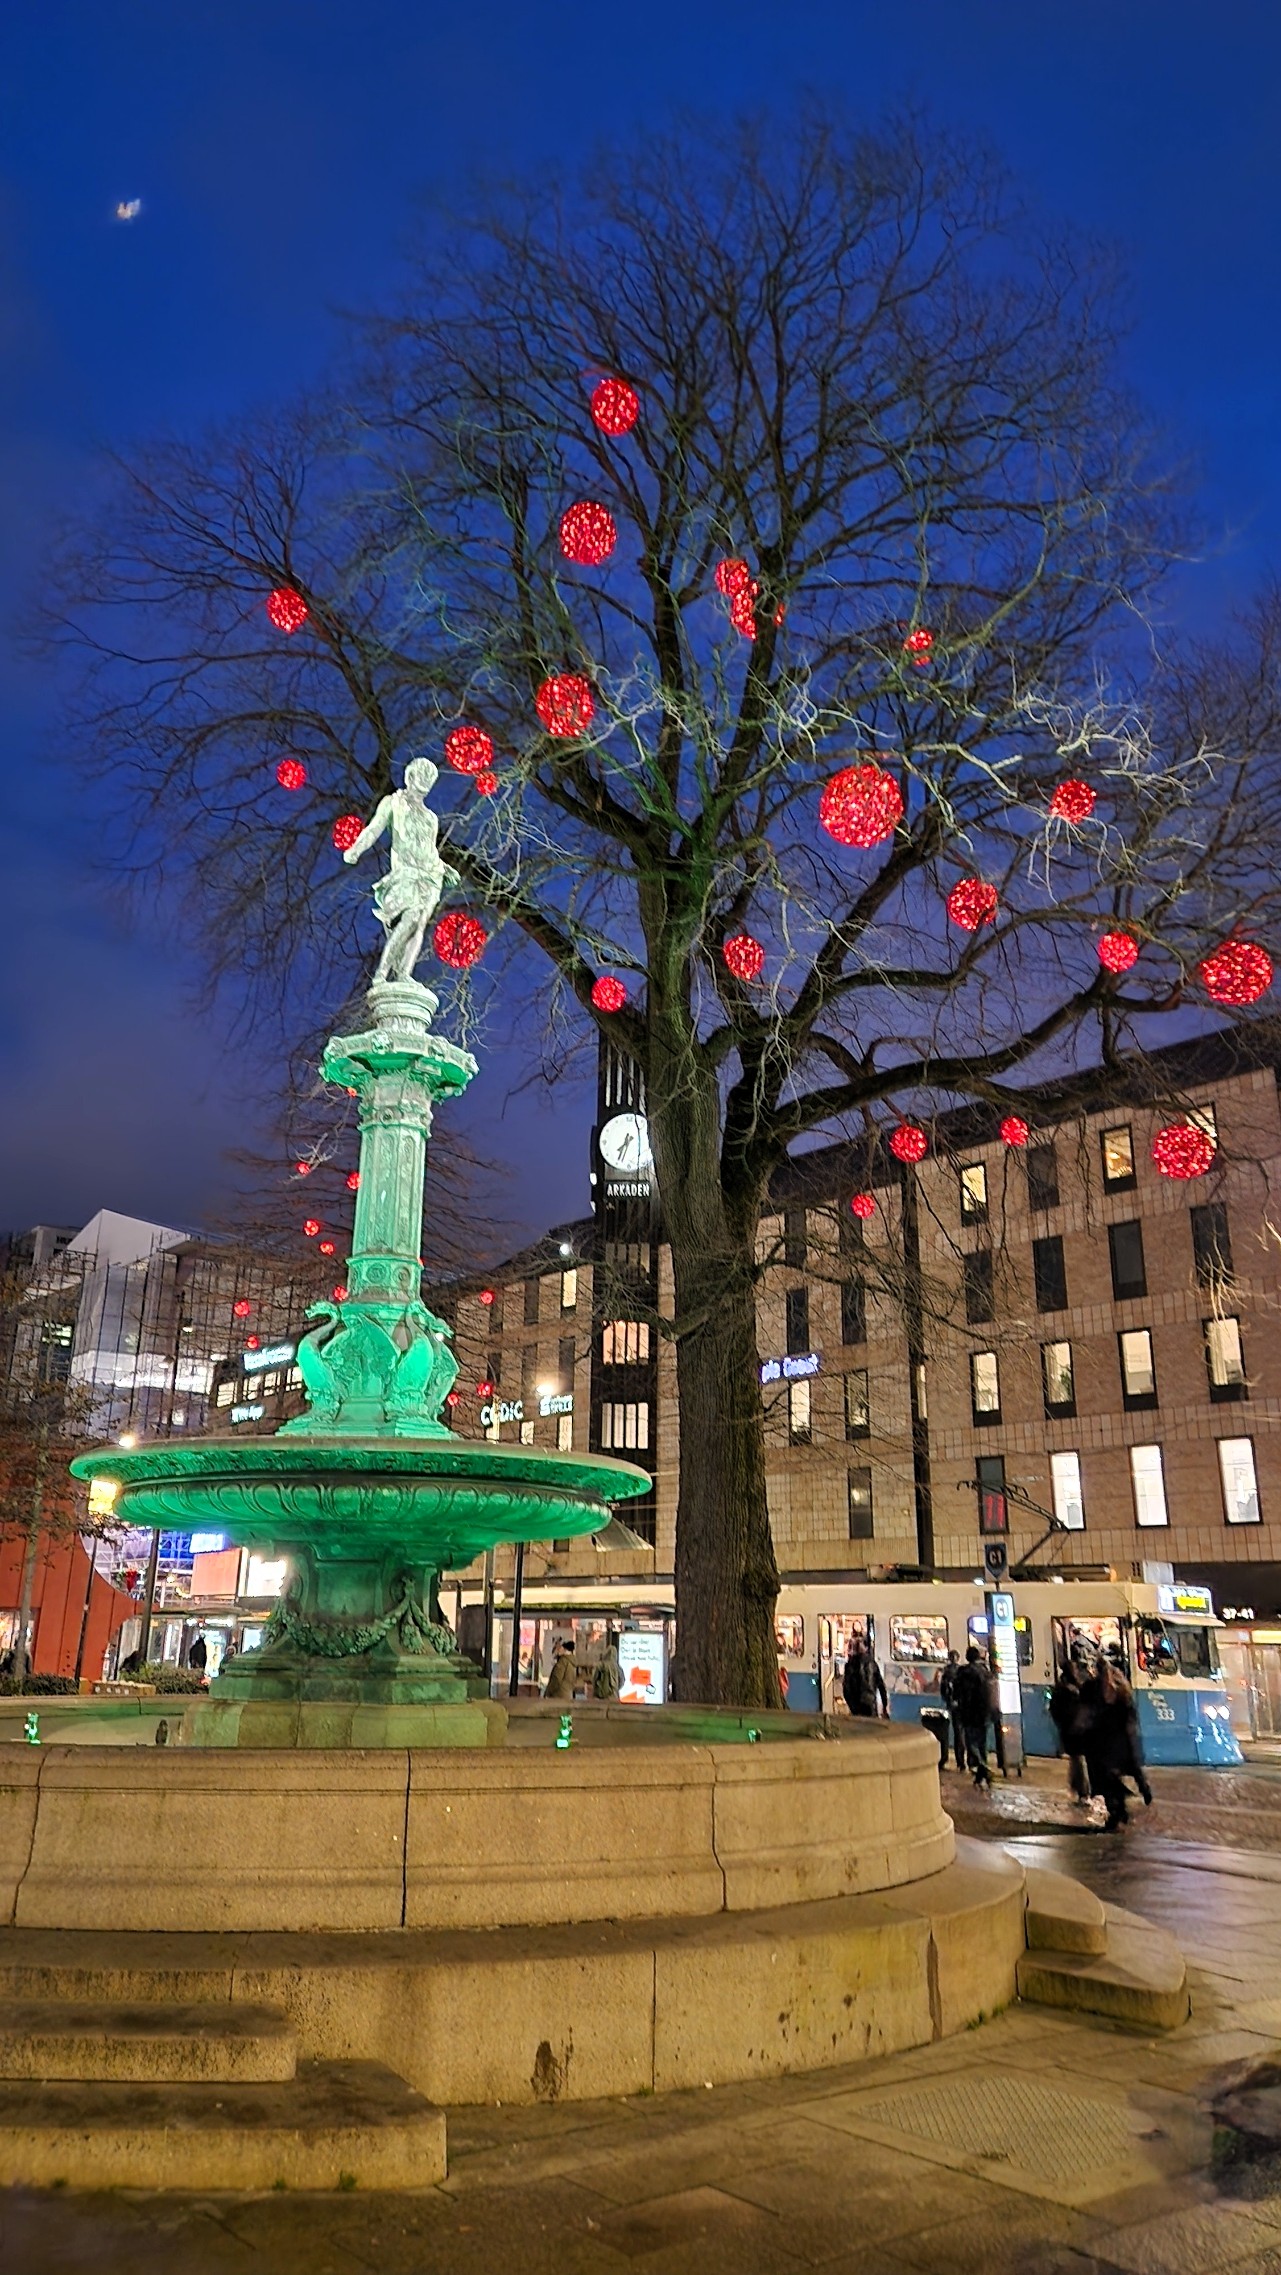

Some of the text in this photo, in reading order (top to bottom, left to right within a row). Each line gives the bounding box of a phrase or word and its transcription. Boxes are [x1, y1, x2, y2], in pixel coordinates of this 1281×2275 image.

[607, 1183, 650, 1197] ARKADEN
[1222, 1607, 1255, 1620] 37-41
[1156, 1708, 1176, 1721] 333
